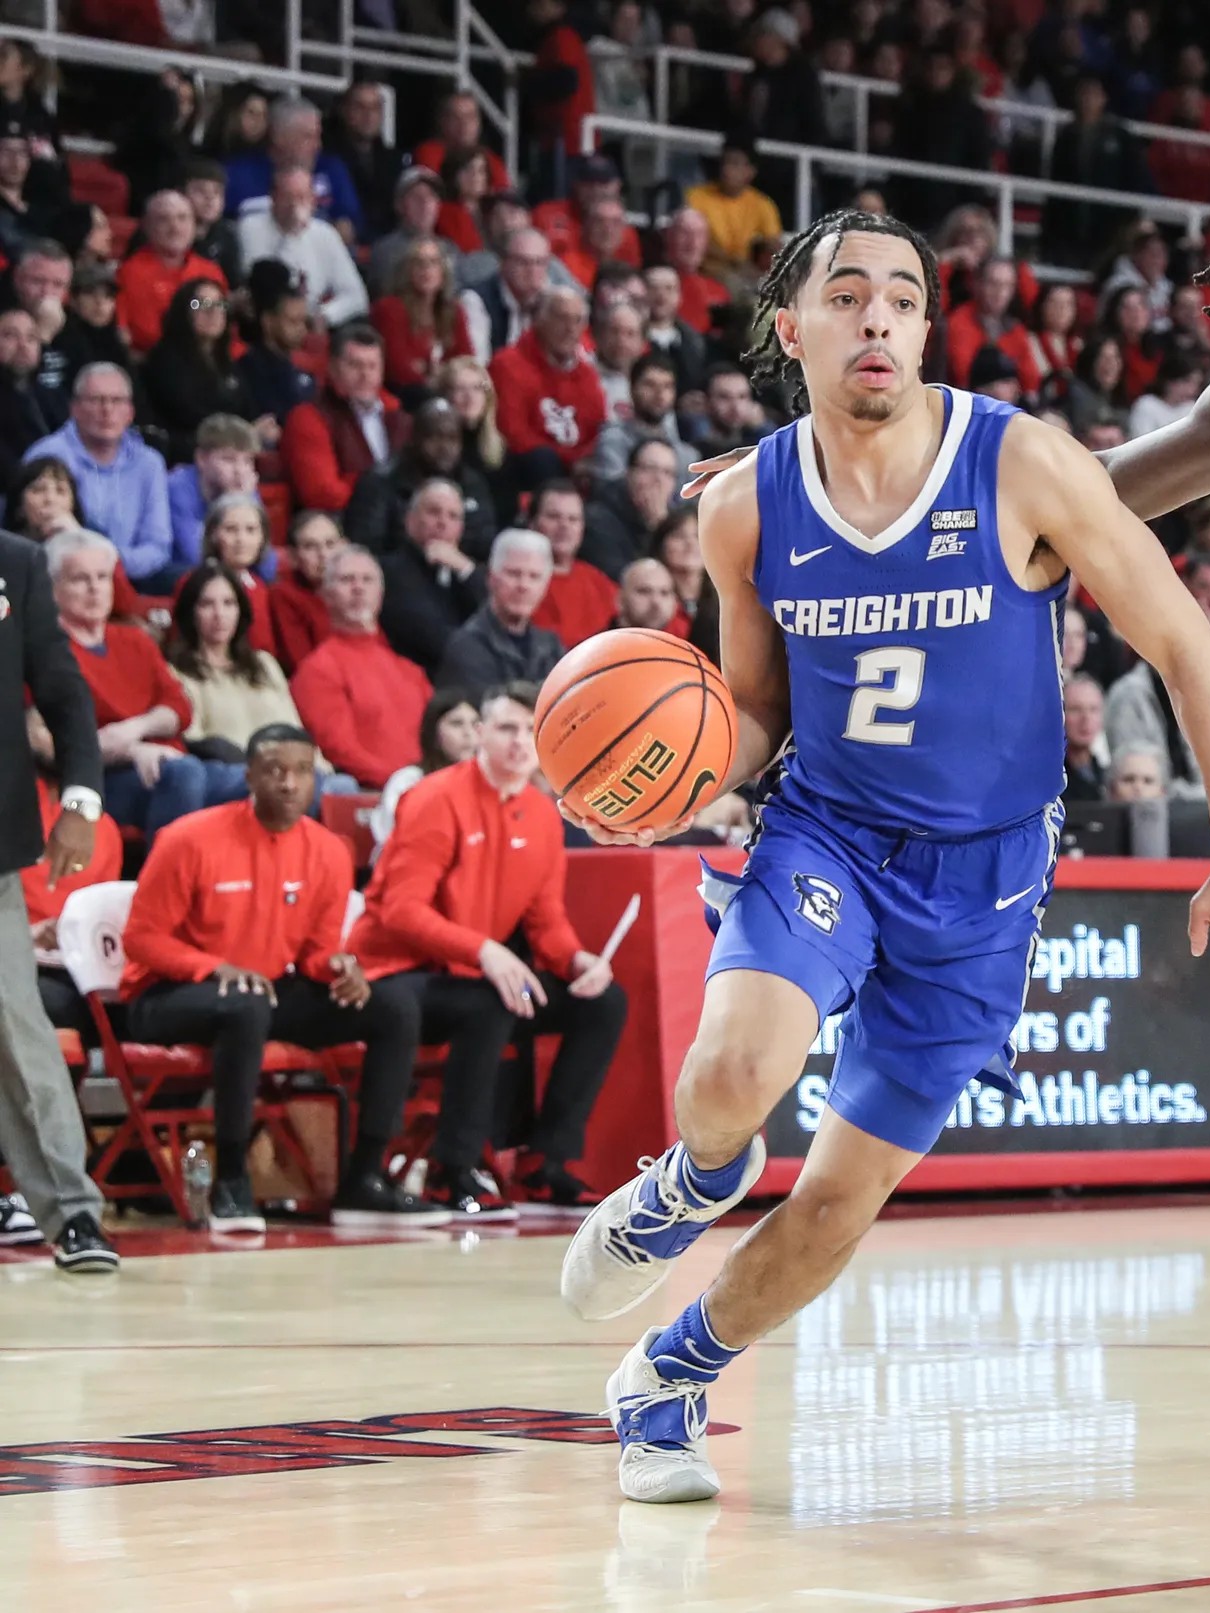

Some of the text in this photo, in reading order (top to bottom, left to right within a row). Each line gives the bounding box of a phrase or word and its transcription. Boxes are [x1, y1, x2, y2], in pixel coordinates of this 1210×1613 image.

[928, 540, 967, 556] EAST
[930, 532, 959, 547] BIG
[773, 584, 993, 637] CREIGHTON
[841, 645, 927, 746] 2
[589, 738, 678, 820] ELITE
[1032, 923, 1141, 993] spital
[1064, 996, 1112, 1052] of
[1010, 1068, 1208, 1127] Athletics.
